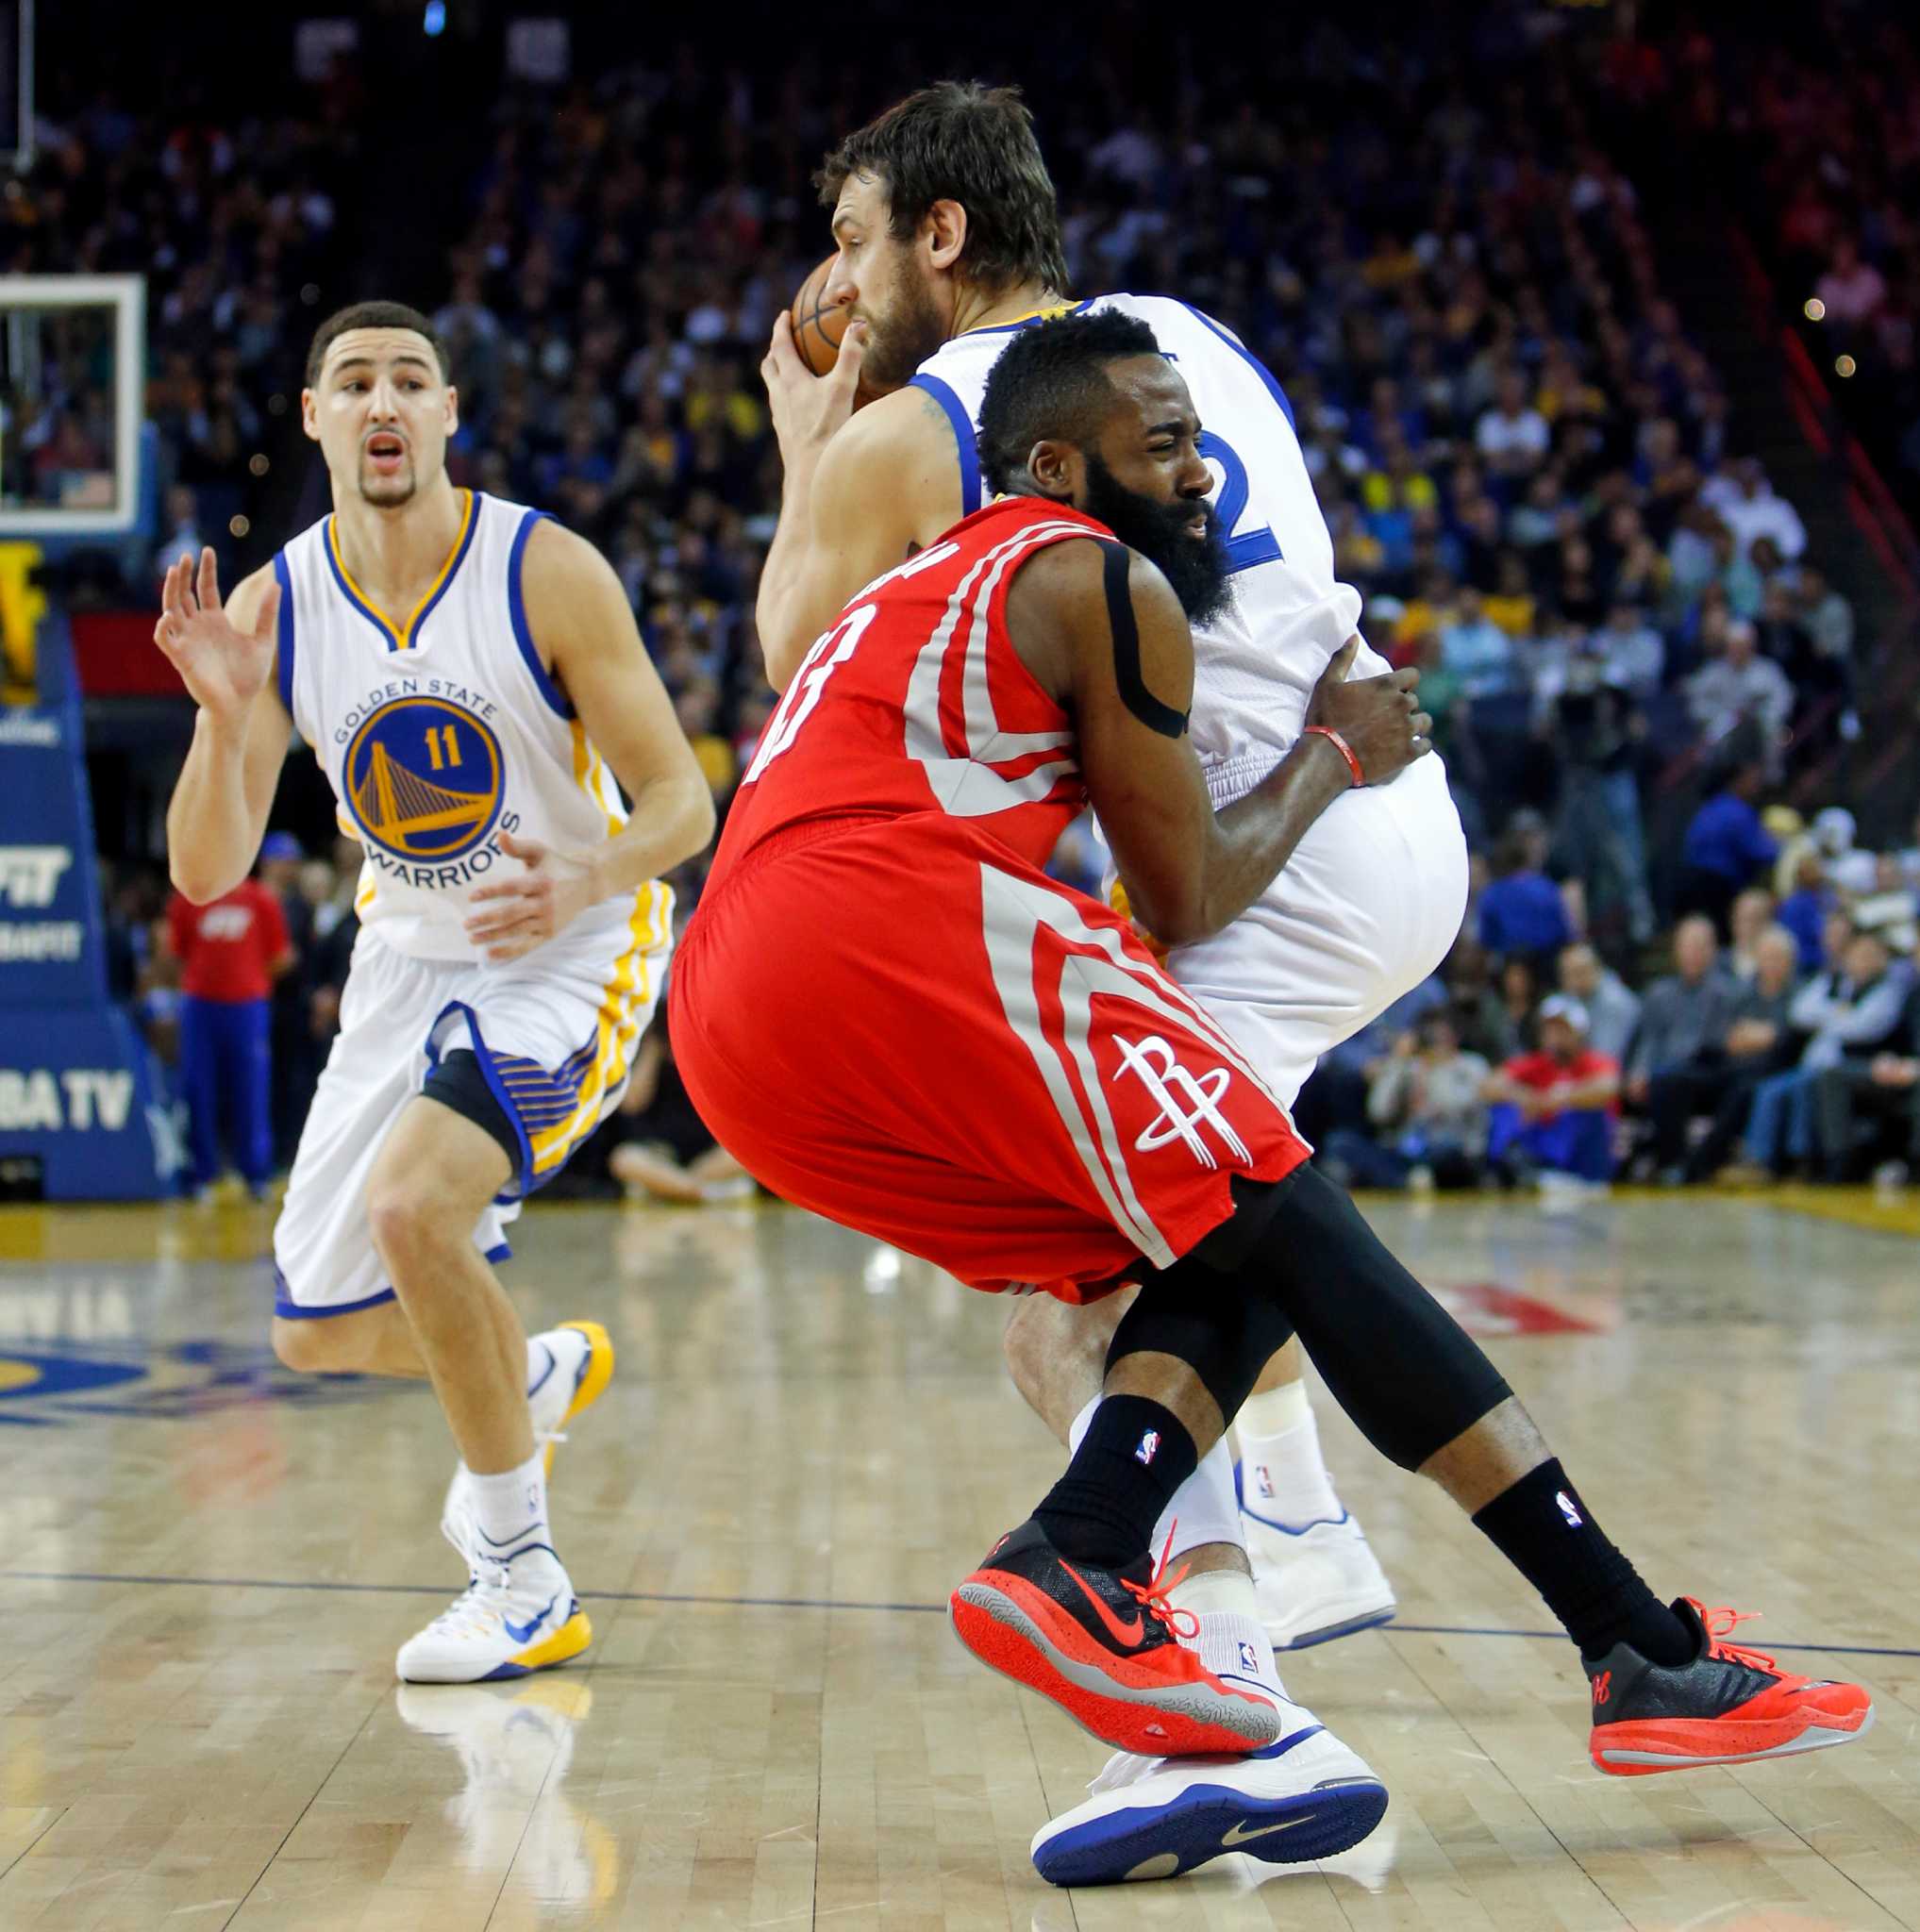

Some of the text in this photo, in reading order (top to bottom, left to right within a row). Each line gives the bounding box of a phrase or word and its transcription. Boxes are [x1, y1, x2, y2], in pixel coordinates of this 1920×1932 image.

[334, 678, 497, 745] GOLDEN STATE
[425, 724, 462, 771] 11
[60, 1069, 134, 1131] TV
